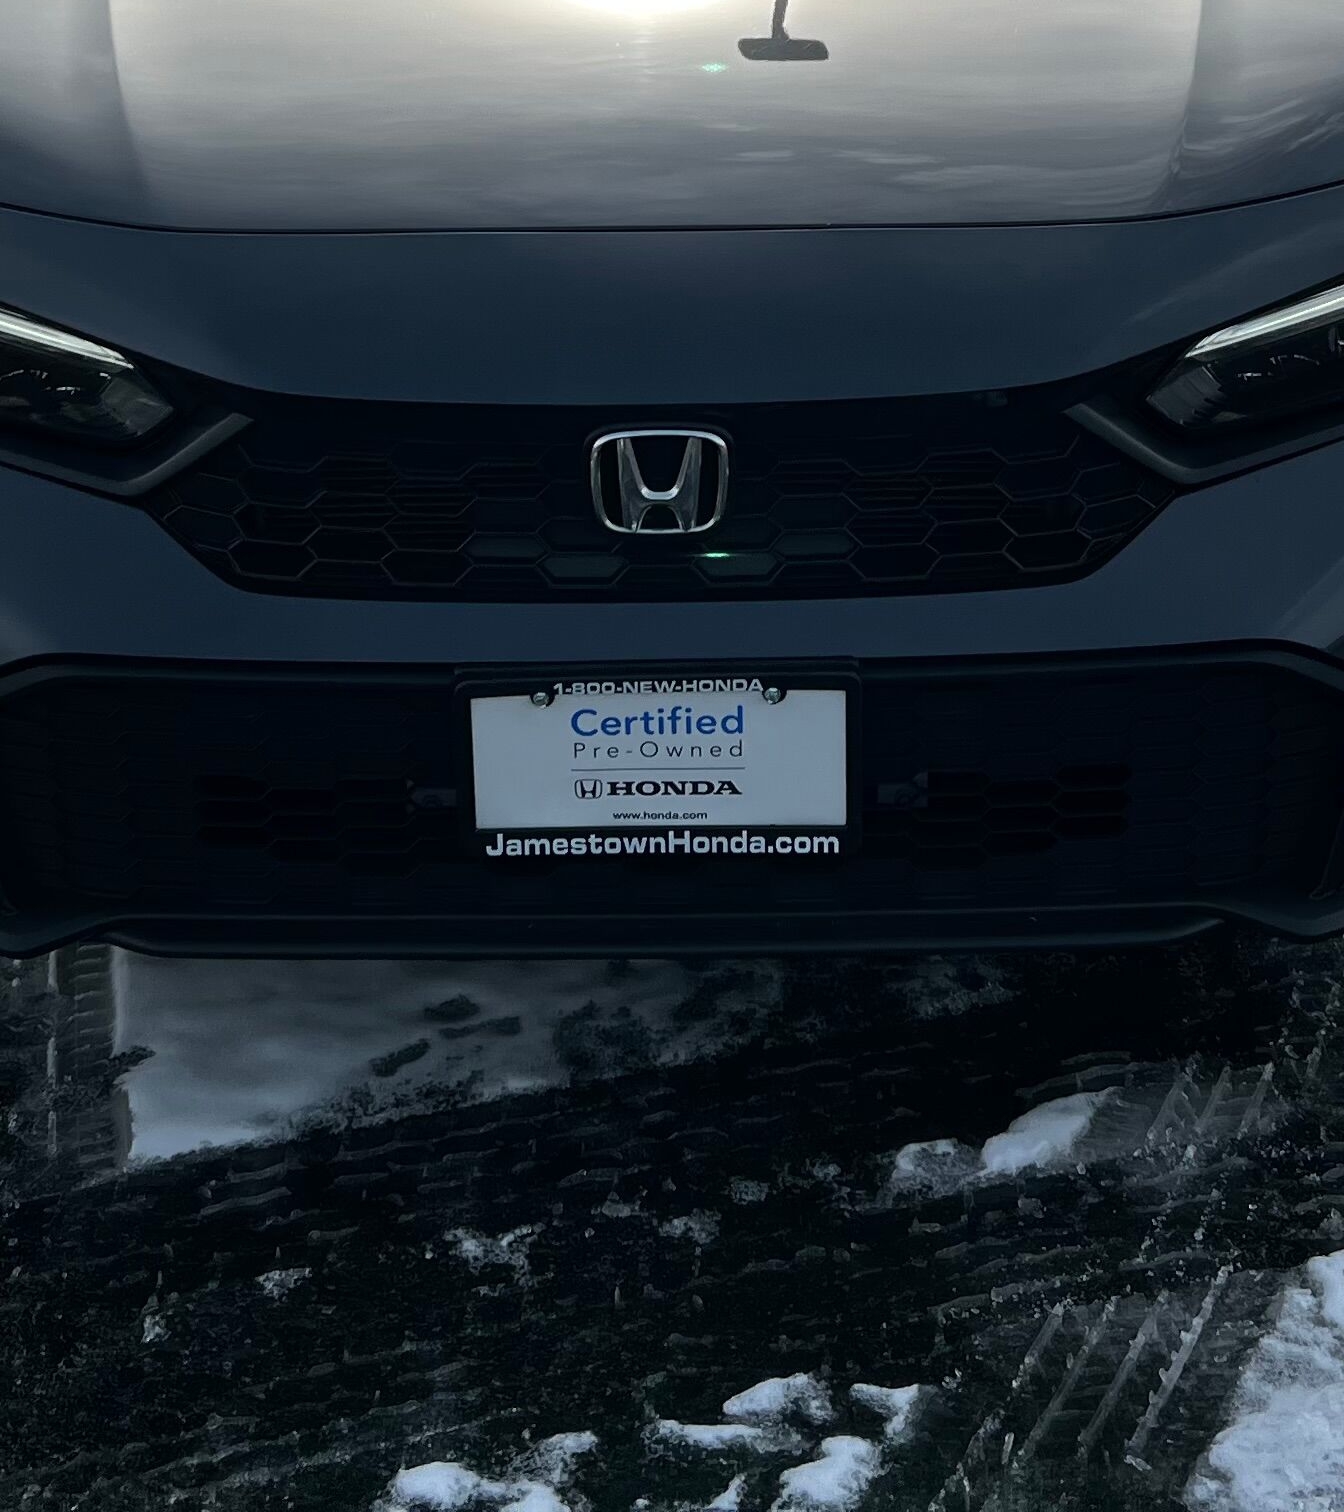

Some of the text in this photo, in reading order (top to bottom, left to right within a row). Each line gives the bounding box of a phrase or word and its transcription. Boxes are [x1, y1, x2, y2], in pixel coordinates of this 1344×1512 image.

[552, 678, 764, 696] 1-800-NEW-HONDA
[570, 704, 745, 737] Certified
[572, 739, 745, 759] Pre-Owned
[606, 779, 743, 796] HONDA
[611, 809, 709, 821] www.honda.com
[485, 829, 840, 857] JamestownHonda.com
